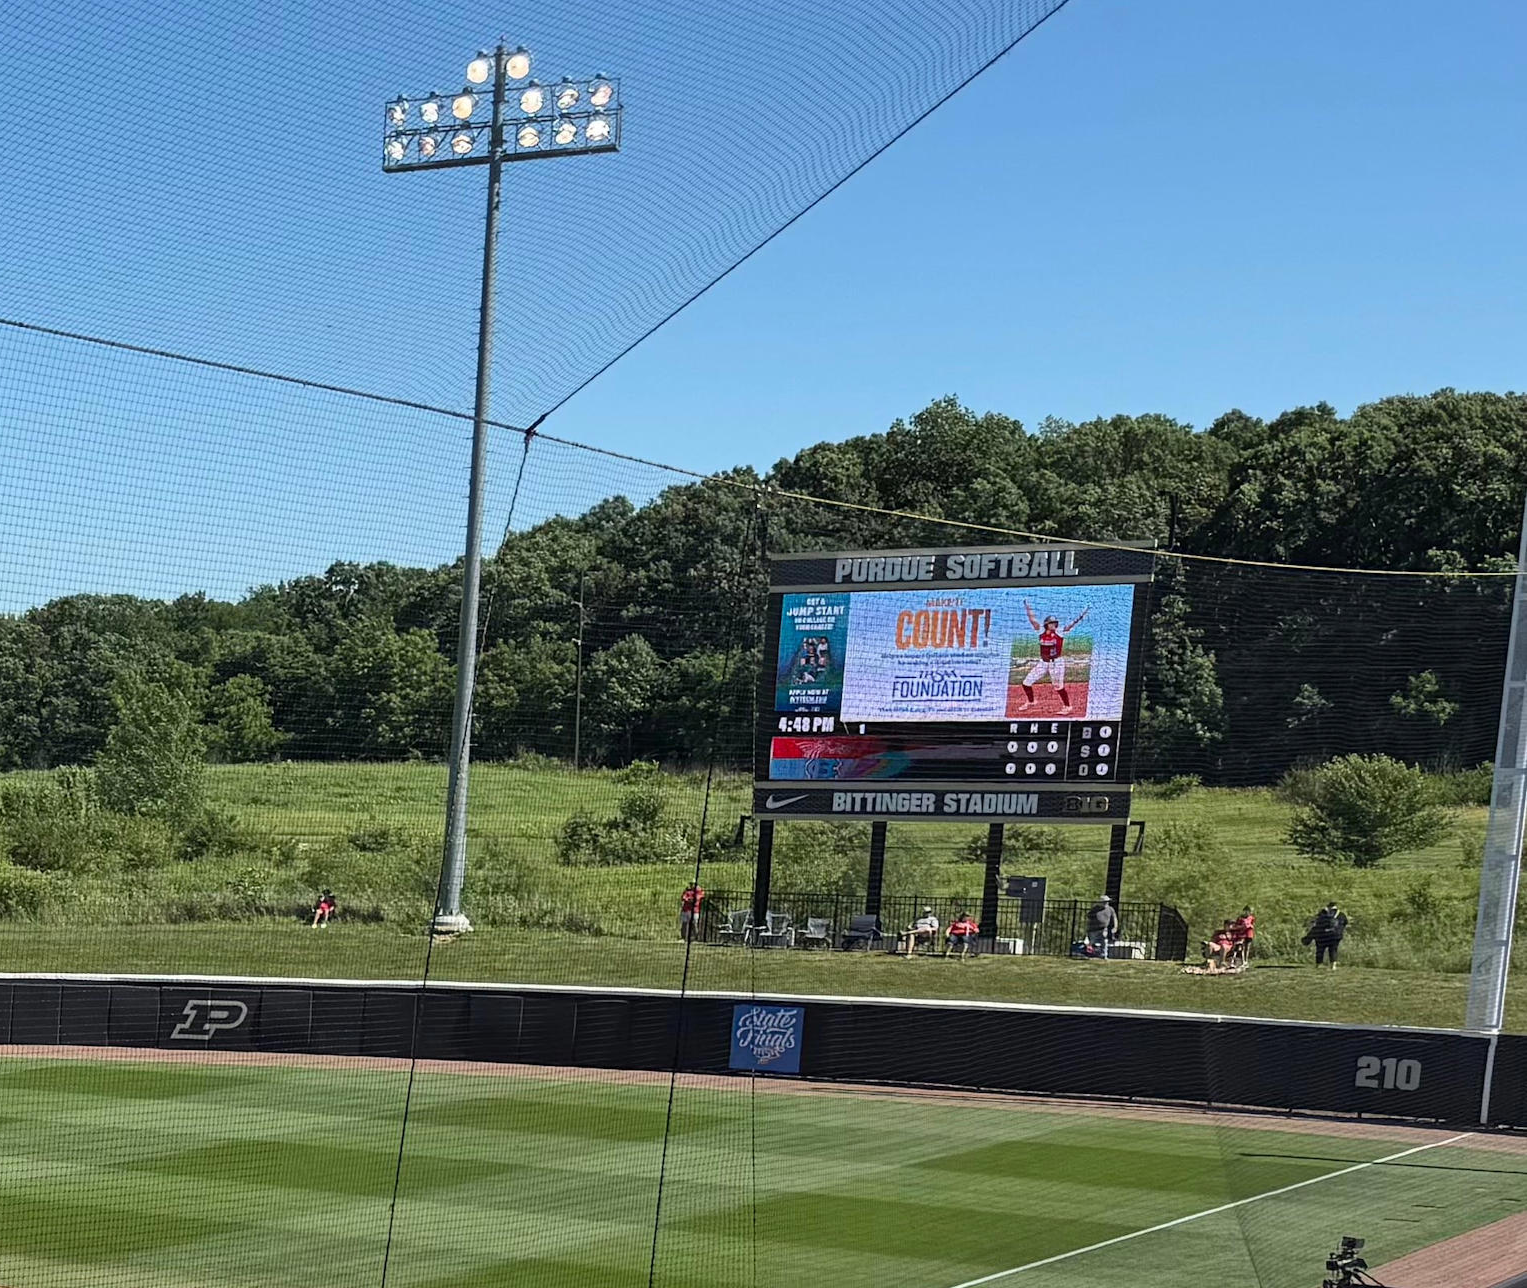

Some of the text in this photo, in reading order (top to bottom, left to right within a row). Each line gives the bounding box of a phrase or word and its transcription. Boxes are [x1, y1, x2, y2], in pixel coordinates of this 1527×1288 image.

[834, 551, 1078, 583] PURDUE SOFTBALL
[787, 605, 845, 616] JUMP START
[895, 609, 992, 650] COUNT!
[892, 680, 983, 698] FOUNDATION
[778, 717, 835, 732] 4:48 PM
[1010, 723, 1018, 734] R
[1050, 723, 1058, 733] E
[832, 792, 1039, 814] BITTINGER STADIUM
[170, 999, 248, 1040] P
[738, 1008, 797, 1029] State
[736, 1027, 796, 1052] Finals
[1355, 1055, 1422, 1091] 210
